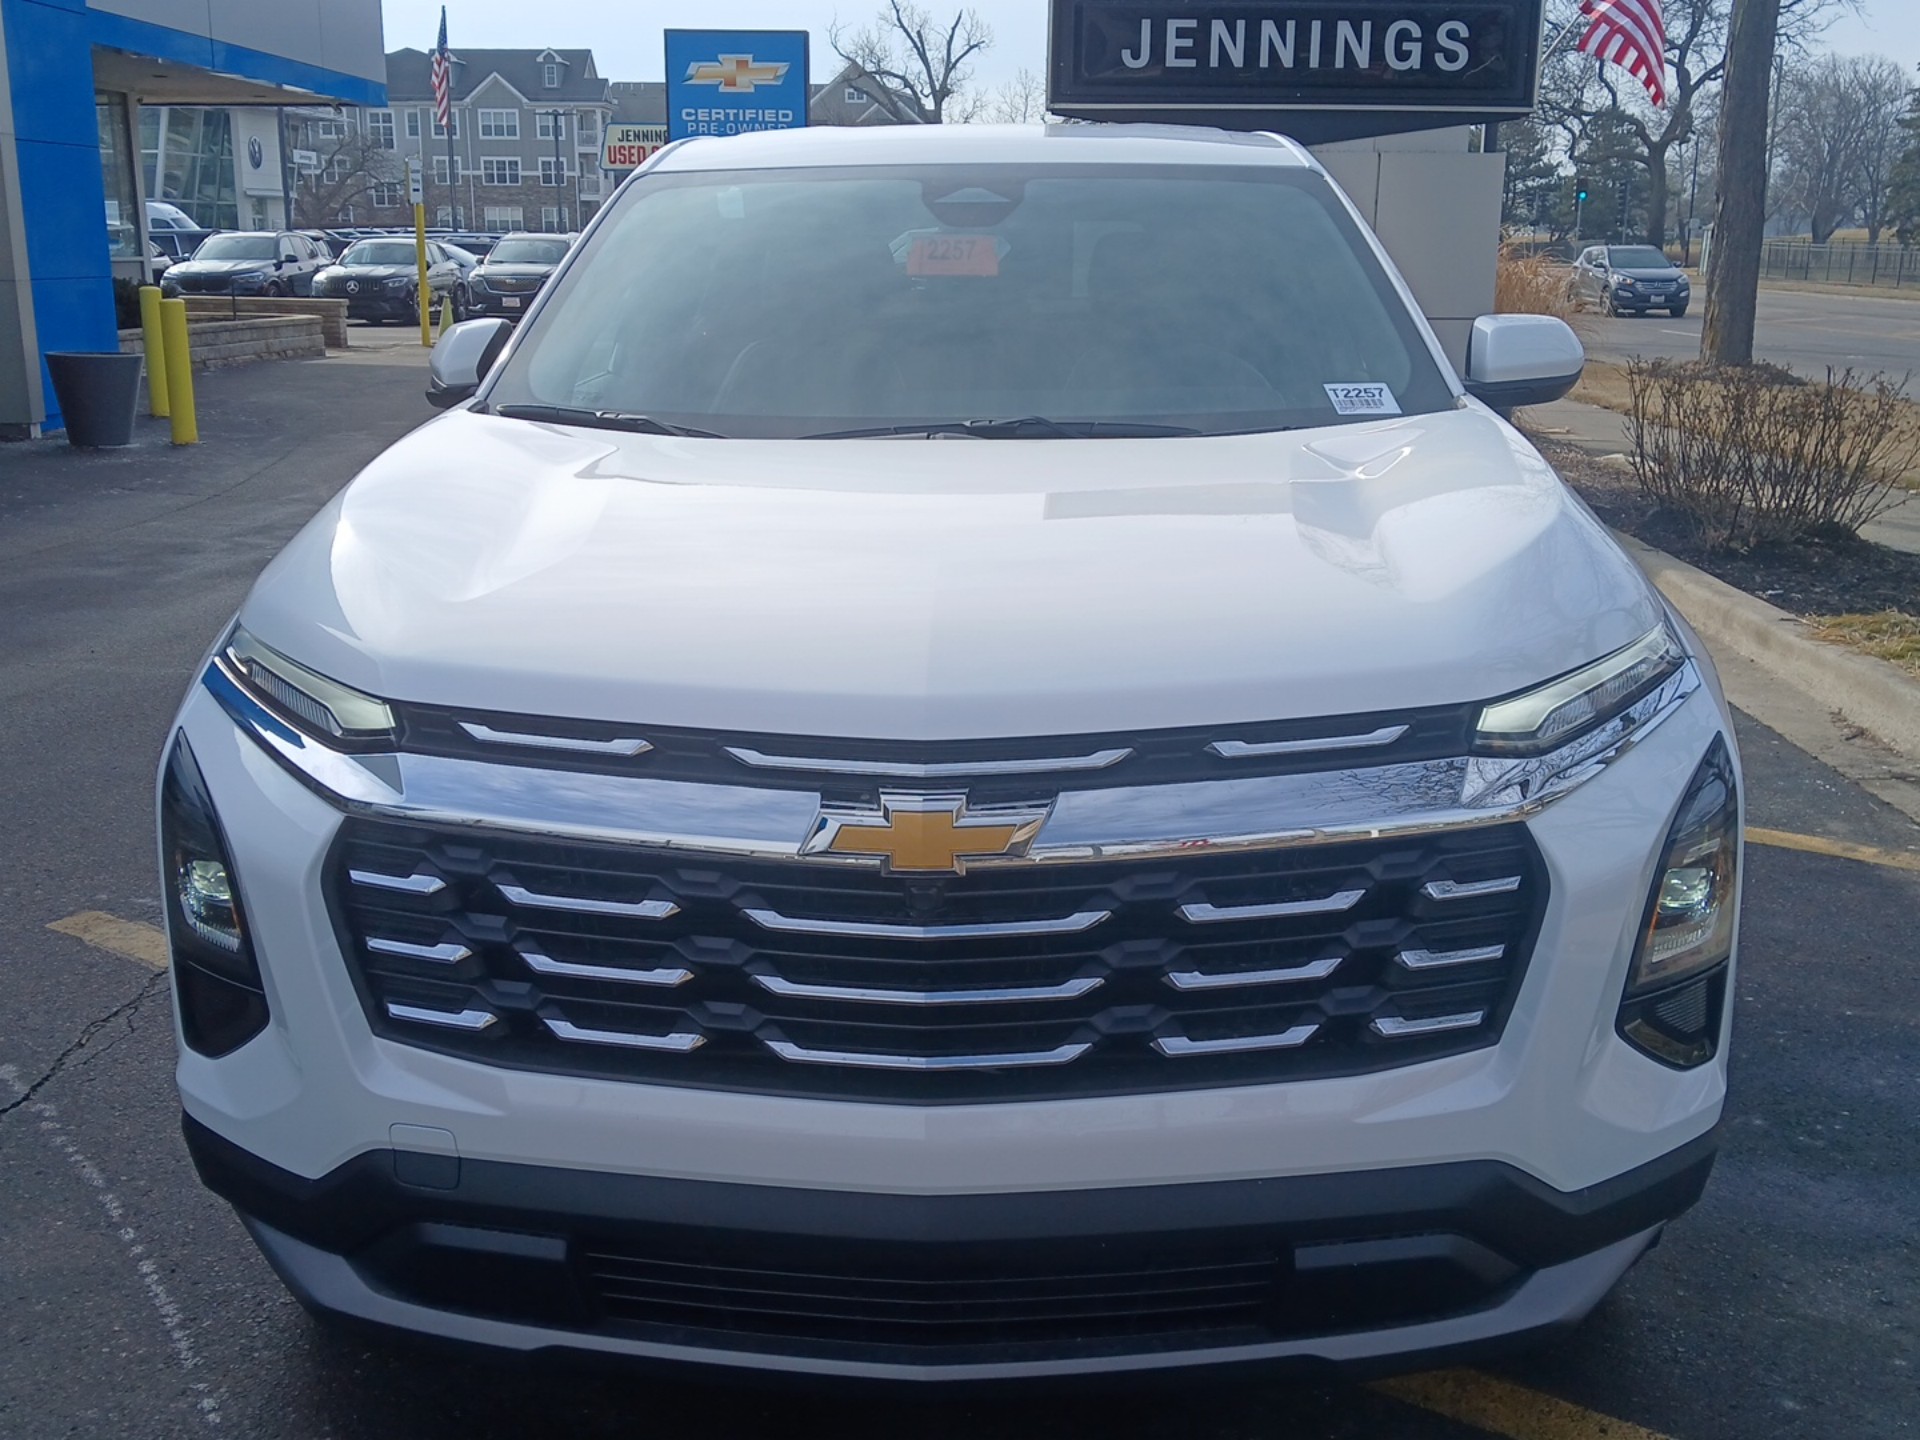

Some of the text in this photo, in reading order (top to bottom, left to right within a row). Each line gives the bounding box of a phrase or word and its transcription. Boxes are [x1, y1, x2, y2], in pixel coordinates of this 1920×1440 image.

[1120, 18, 1470, 72] JENNINGS
[681, 108, 793, 122] CERTIFIED
[608, 145, 646, 165] USED
[927, 239, 977, 261] 2257
[1328, 387, 1384, 398] T2257
